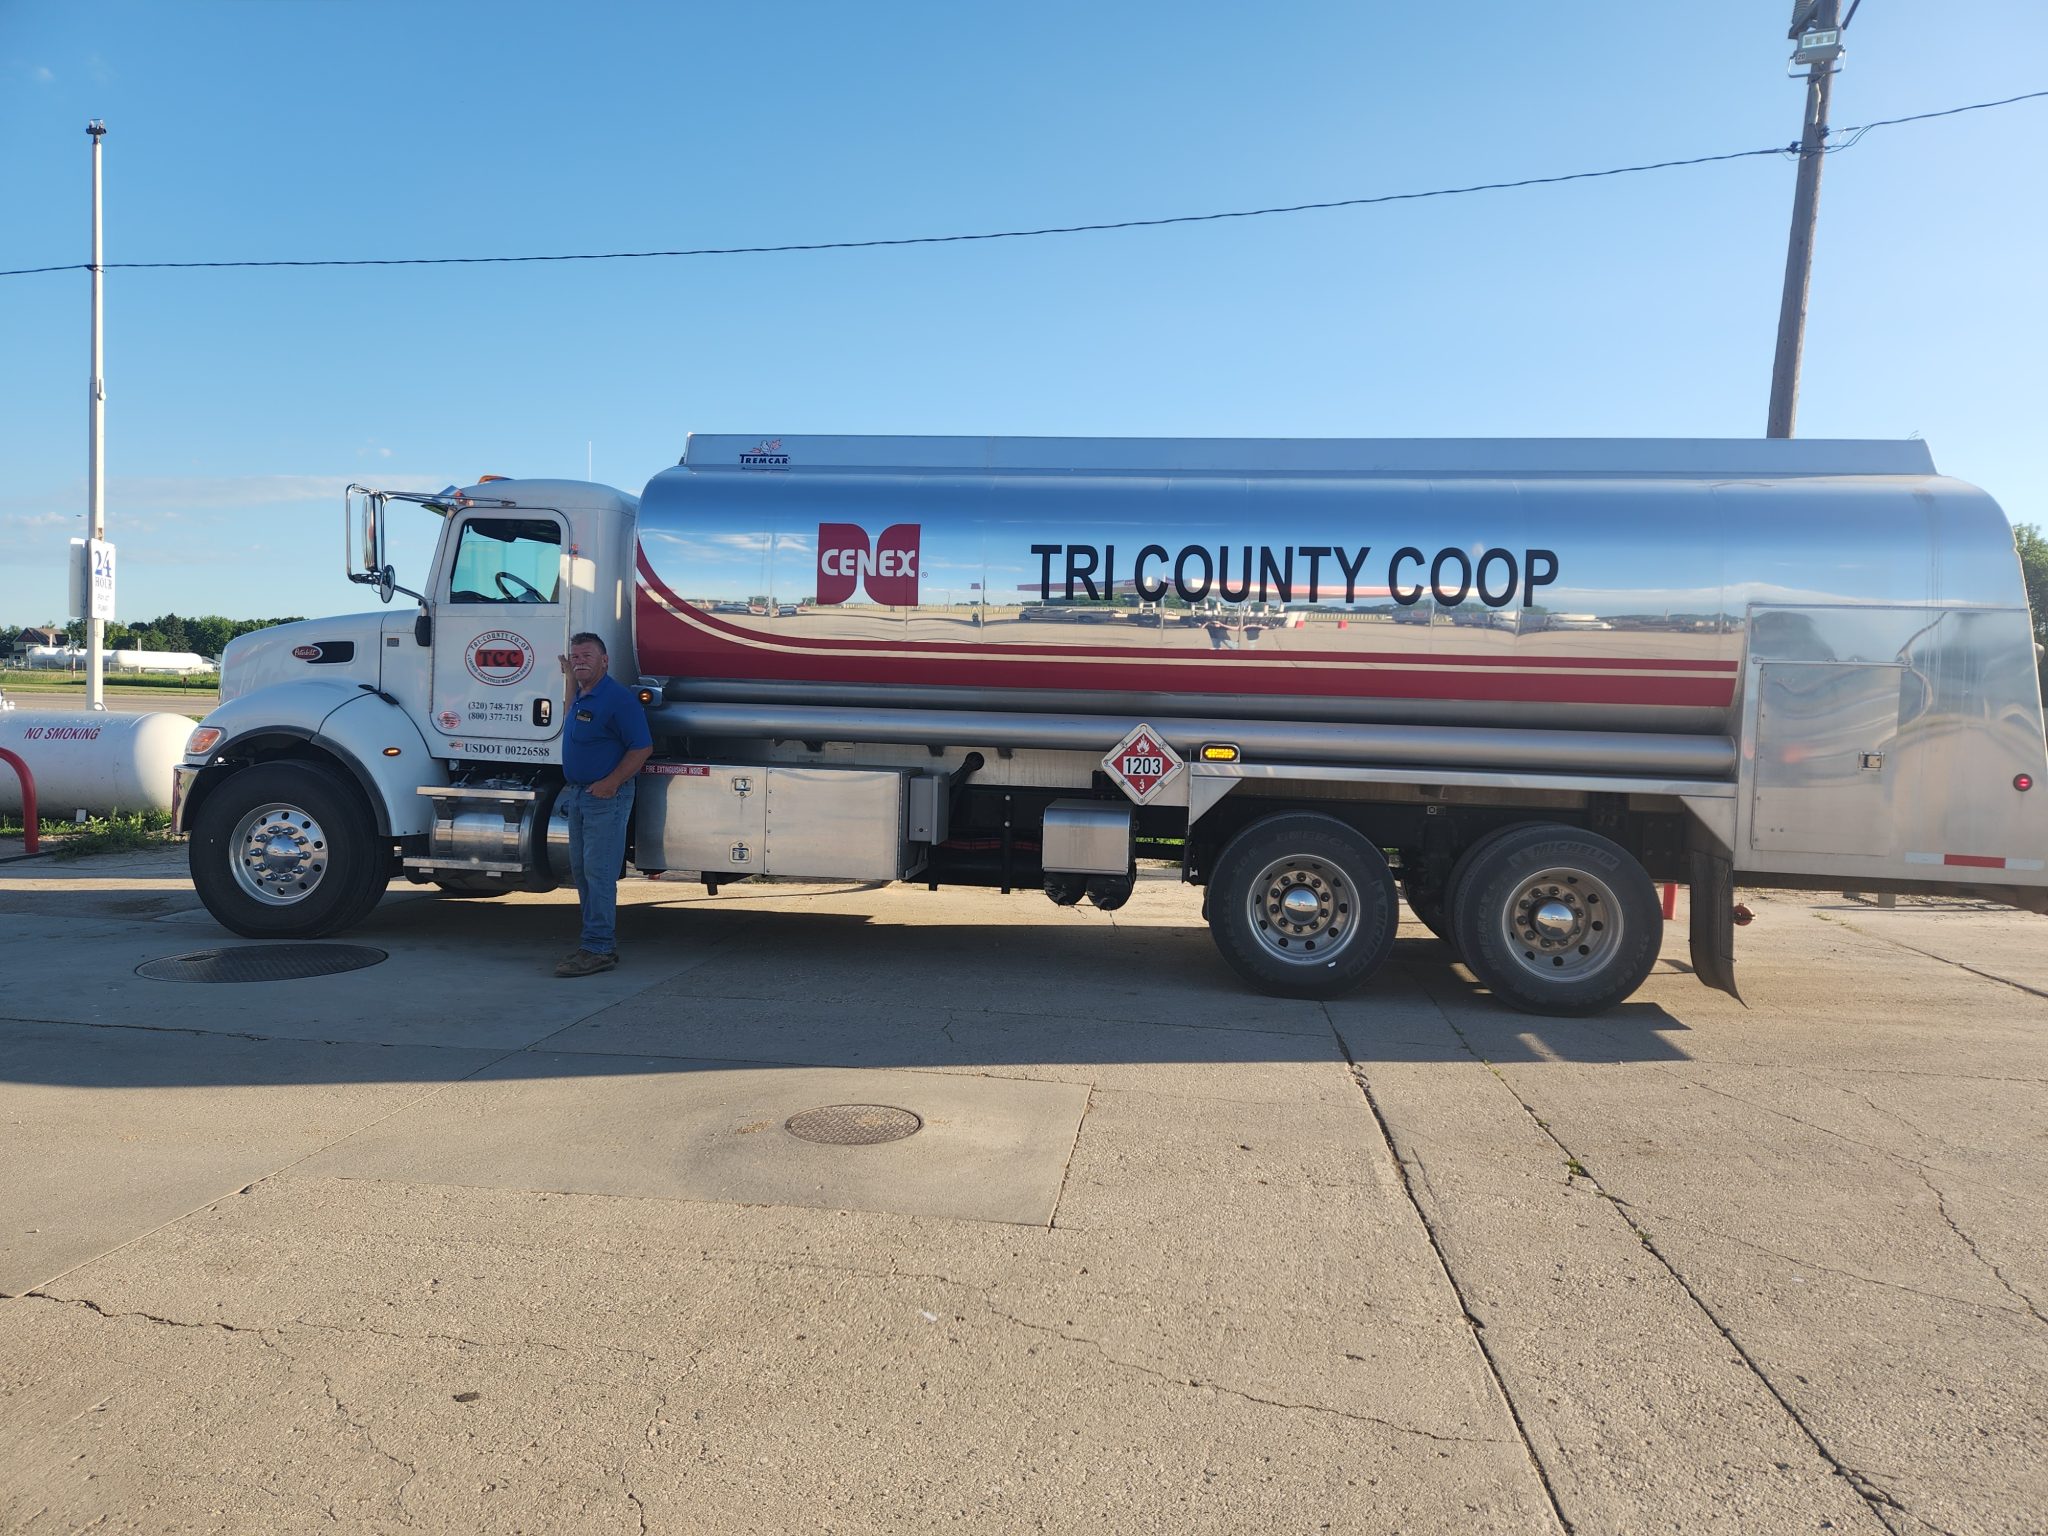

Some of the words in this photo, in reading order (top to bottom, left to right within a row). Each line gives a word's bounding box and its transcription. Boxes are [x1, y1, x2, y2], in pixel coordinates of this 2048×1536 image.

[739, 454, 789, 464] TREMCAR
[94, 550, 112, 578] 24
[821, 548, 916, 577] CENEX
[95, 576, 112, 590] HOUR
[1030, 544, 1114, 602] TRI
[1134, 544, 1371, 604] COUNTY
[1388, 546, 1560, 608] COOP
[510, 635, 529, 651] CO-OP
[480, 650, 520, 668] TCC
[468, 701, 488, 711] (320)
[489, 702, 524, 711] 748-7187
[468, 711, 488, 721] (800)
[489, 713, 523, 722] 377-7151
[24, 727, 44, 740] NO
[44, 727, 101, 740] SMOKING
[464, 743, 503, 754] USDOT
[505, 745, 550, 757] 00226588
[645, 765, 657, 773] FIRE
[657, 765, 688, 774] EXTINGUISHER
[688, 766, 704, 775] INSIDE
[1126, 758, 1160, 774] 1203
[1139, 780, 1145, 790] 3
[1534, 842, 1618, 870] MICHELIN
